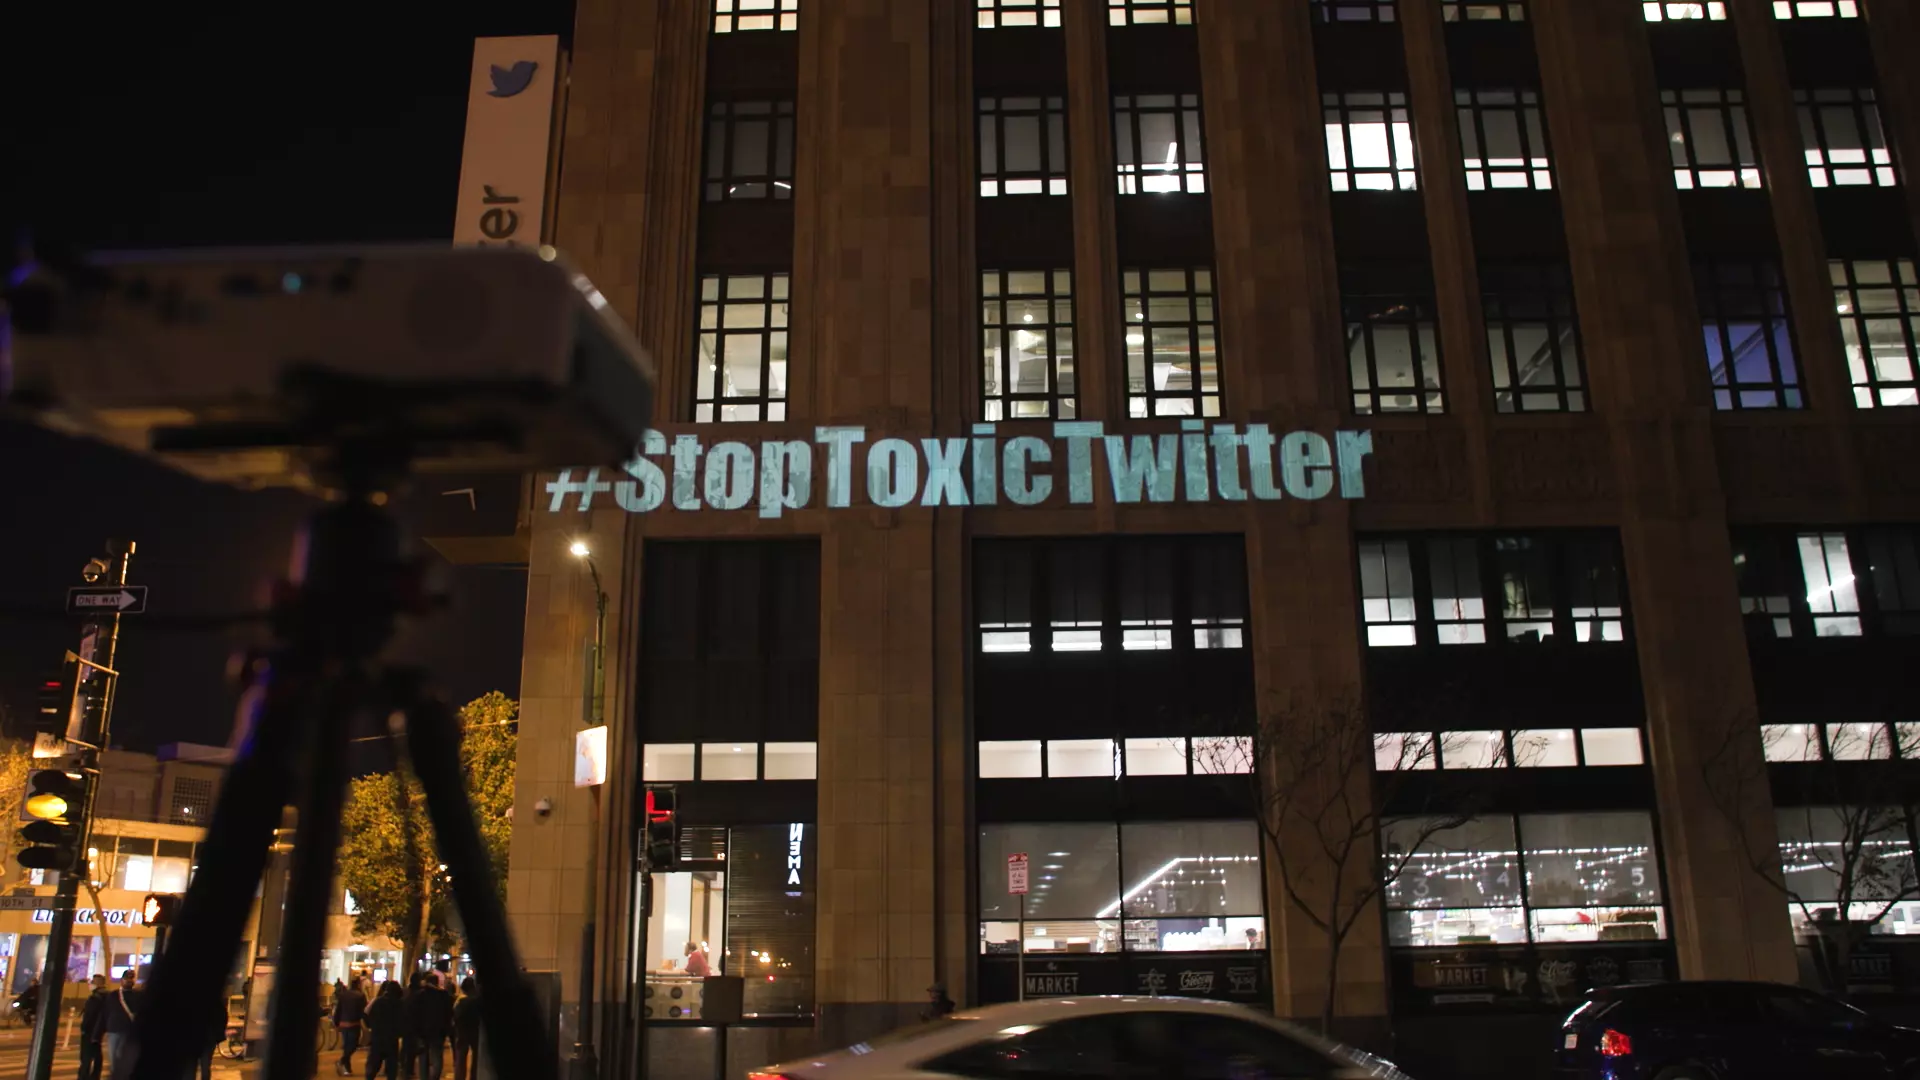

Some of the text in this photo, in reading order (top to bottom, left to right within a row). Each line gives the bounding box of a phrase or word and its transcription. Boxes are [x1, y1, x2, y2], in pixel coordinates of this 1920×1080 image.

[545, 420, 1373, 519] #StopToxicTwitter
[77, 596, 122, 605] ONE WAY
[1495, 871, 1511, 889] 4
[1630, 866, 1646, 887] 5
[1413, 876, 1431, 898] 3
[1026, 976, 1079, 994] MARKET
[1434, 967, 1489, 985] MARKET
